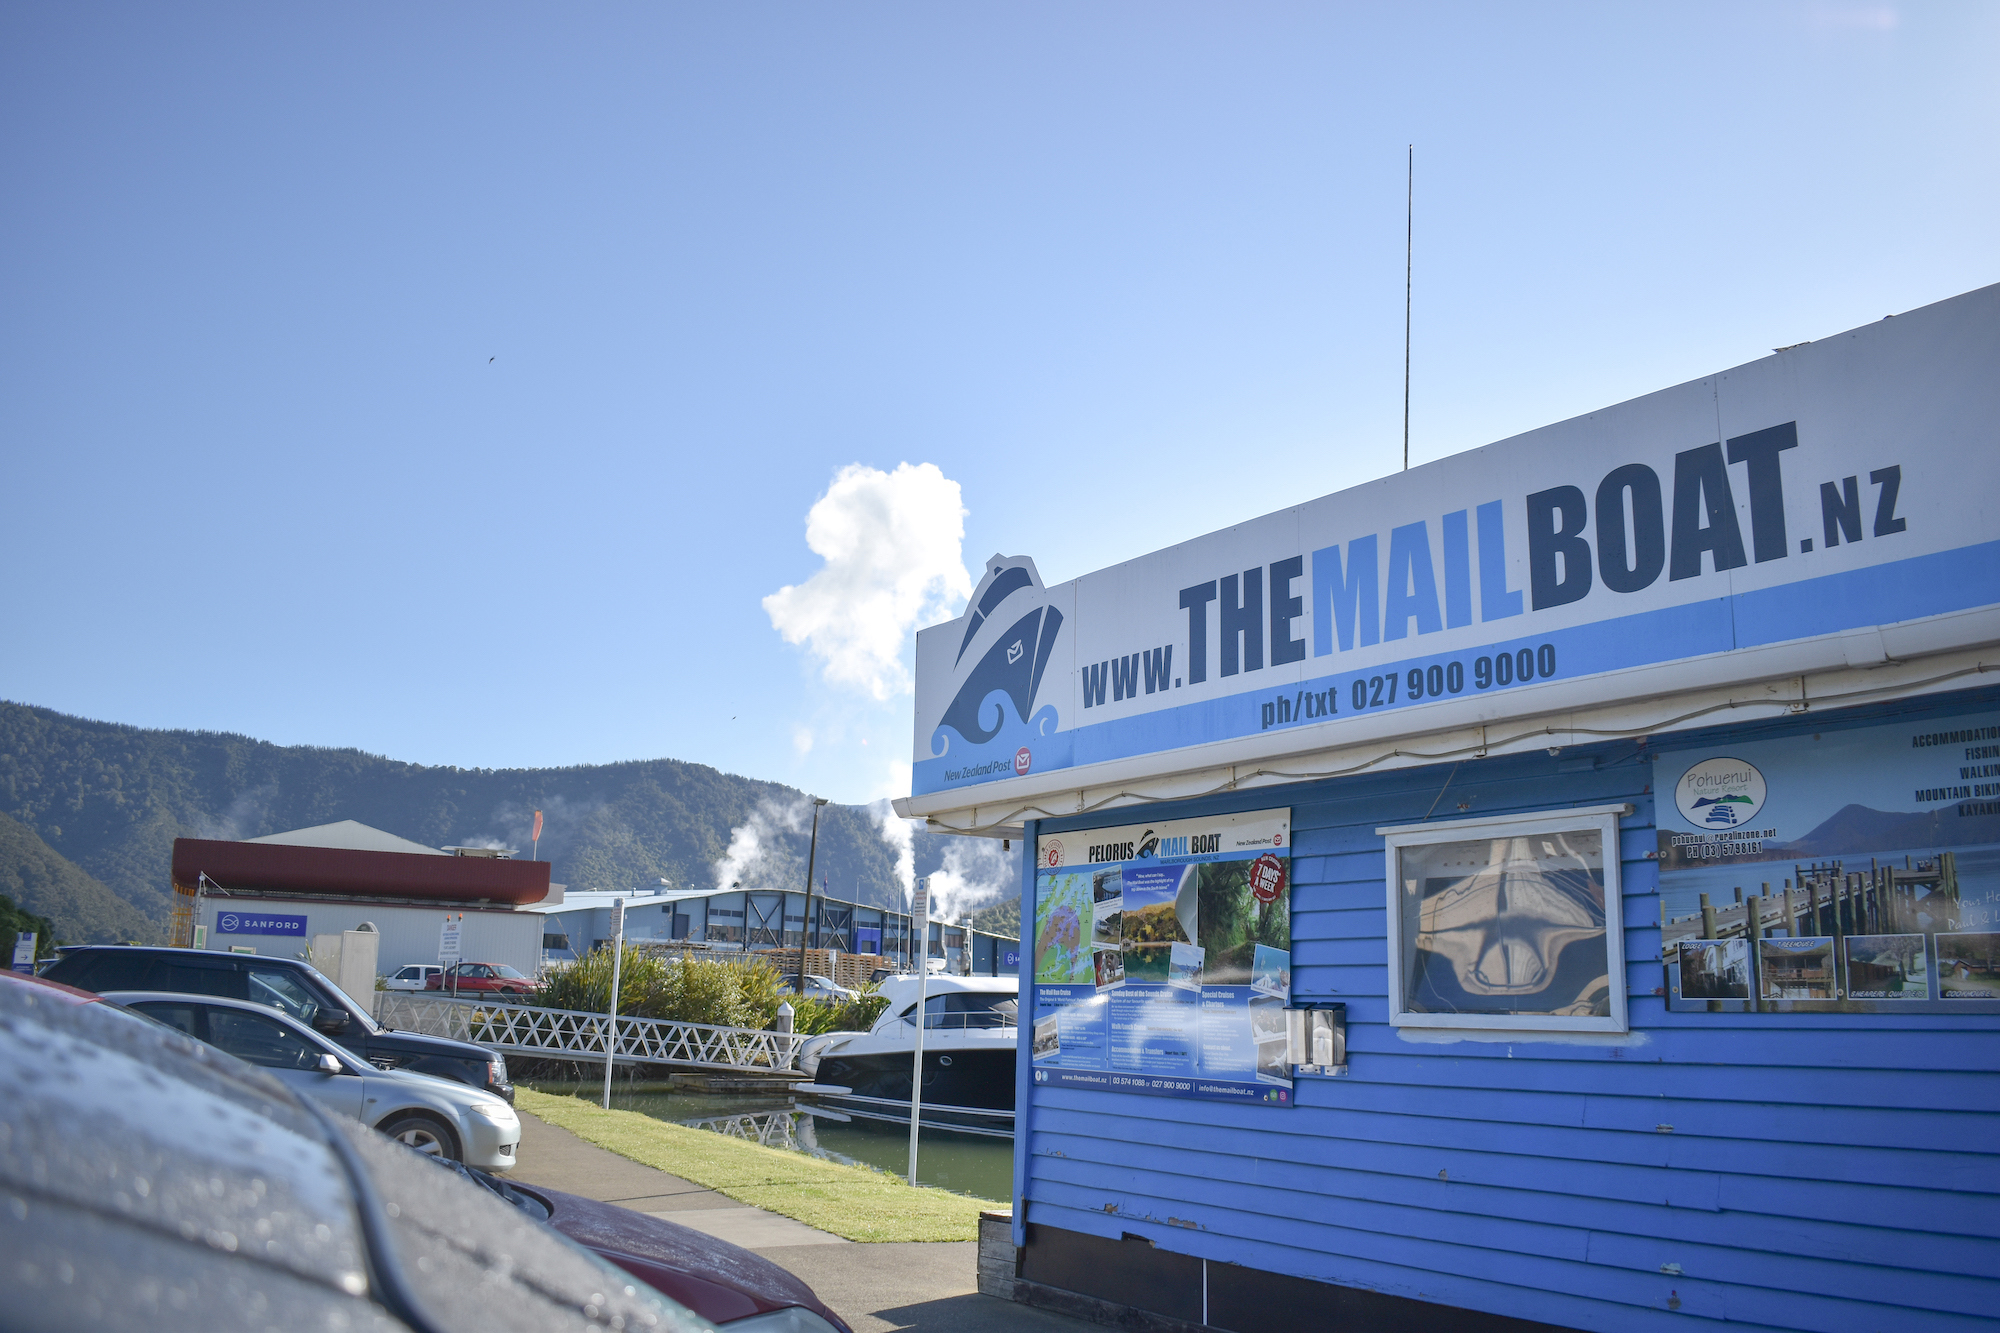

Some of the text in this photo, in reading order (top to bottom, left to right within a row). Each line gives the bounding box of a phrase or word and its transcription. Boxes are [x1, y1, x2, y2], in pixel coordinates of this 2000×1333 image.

[1261, 643, 1556, 730] ph/txt 027 900 9000
[944, 758, 1011, 782] New Zealand Post
[1687, 768, 1752, 788] Pohuenui
[1693, 784, 1748, 795] Nature Resort
[1915, 785, 1971, 802] MOUNTAIN
[1672, 828, 1777, 847] pohuenui@ruralinzone.net
[1089, 833, 1221, 862] PELORUS MAIL BOAT
[1687, 842, 1763, 859] PH (03) 5798161
[1160, 857, 1192, 865] MARLBOROUGH
[1257, 863, 1263, 876] 7
[1254, 876, 1276, 893] A WEEK
[244, 920, 299, 929] SANFORD
[1948, 915, 1978, 930] Paul
[1981, 911, 1990, 924] &
[1218, 991, 1234, 999] Cruises
[1946, 990, 1991, 998] COOKHOUSE
[1113, 1076, 1120, 1084] 03
[1121, 1077, 1131, 1085] 574
[1152, 1080, 1162, 1088] 027
[1164, 1081, 1174, 1089] 900
[1176, 1082, 1191, 1091] 9000
[1199, 1085, 1254, 1096] info@themailboat.nz
